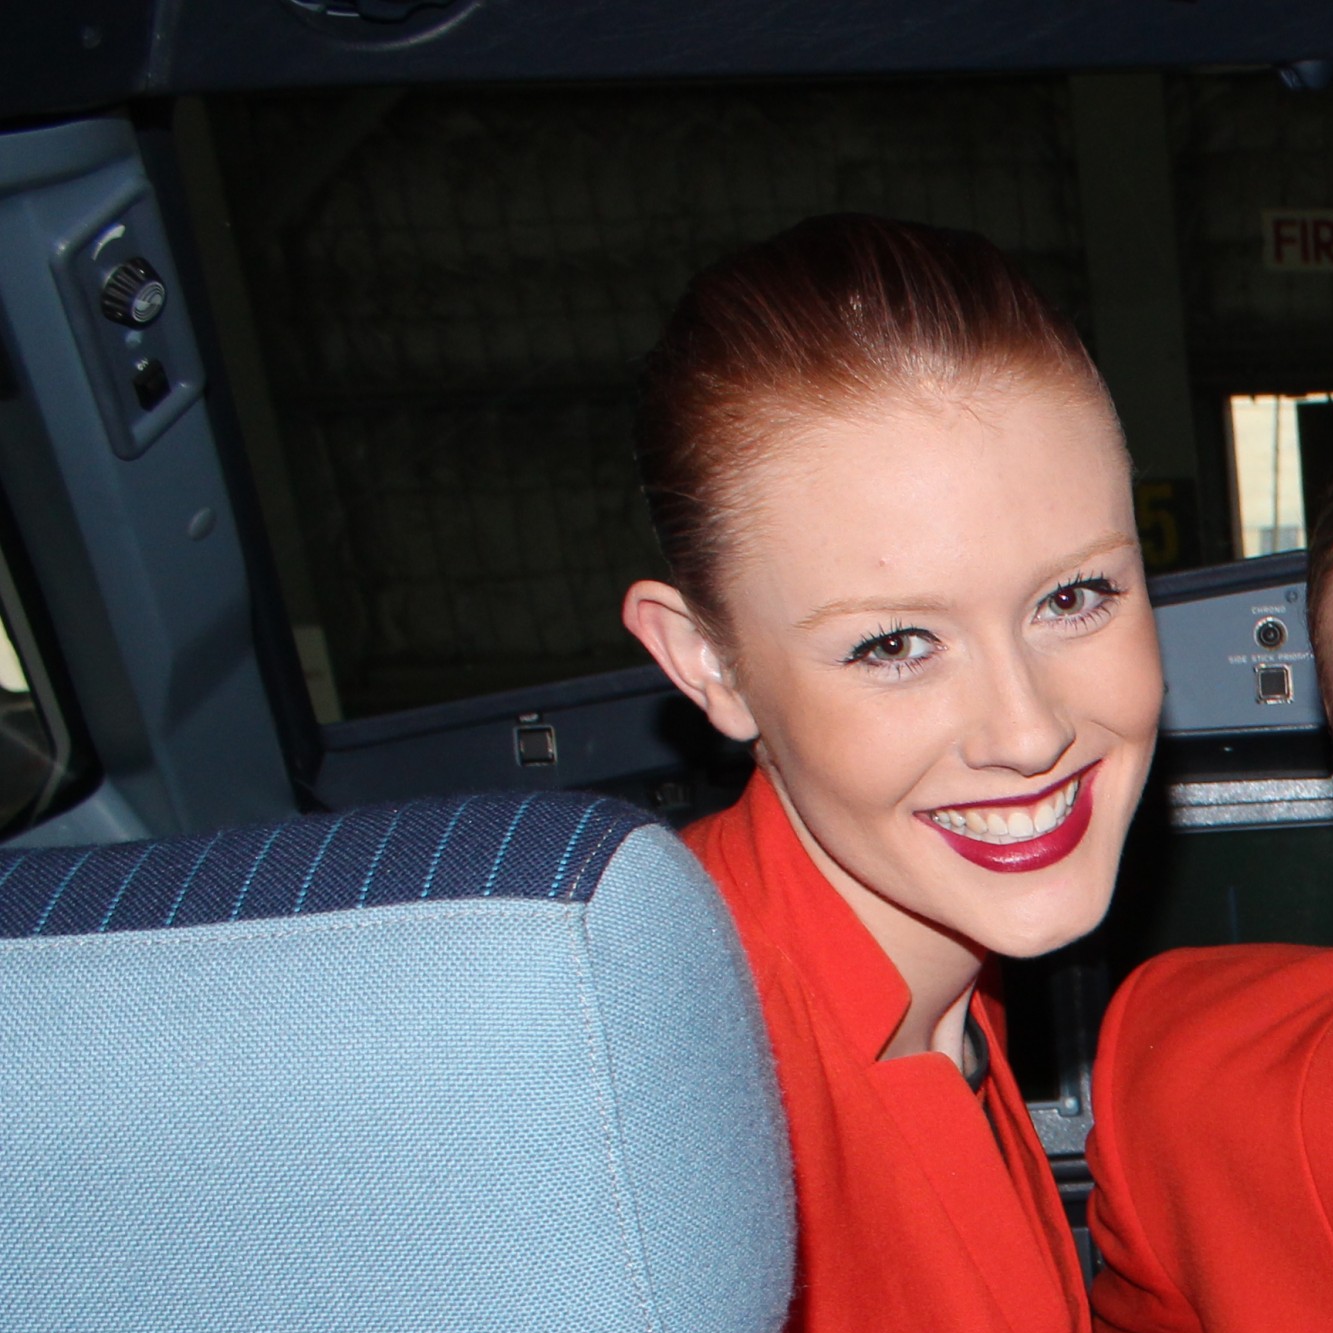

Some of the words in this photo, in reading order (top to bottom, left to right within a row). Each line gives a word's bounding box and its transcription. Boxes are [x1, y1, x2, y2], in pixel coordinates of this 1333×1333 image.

[1251, 606, 1286, 615] CHRONO
[1228, 655, 1247, 664] SIDE
[1252, 654, 1275, 662] STICK
